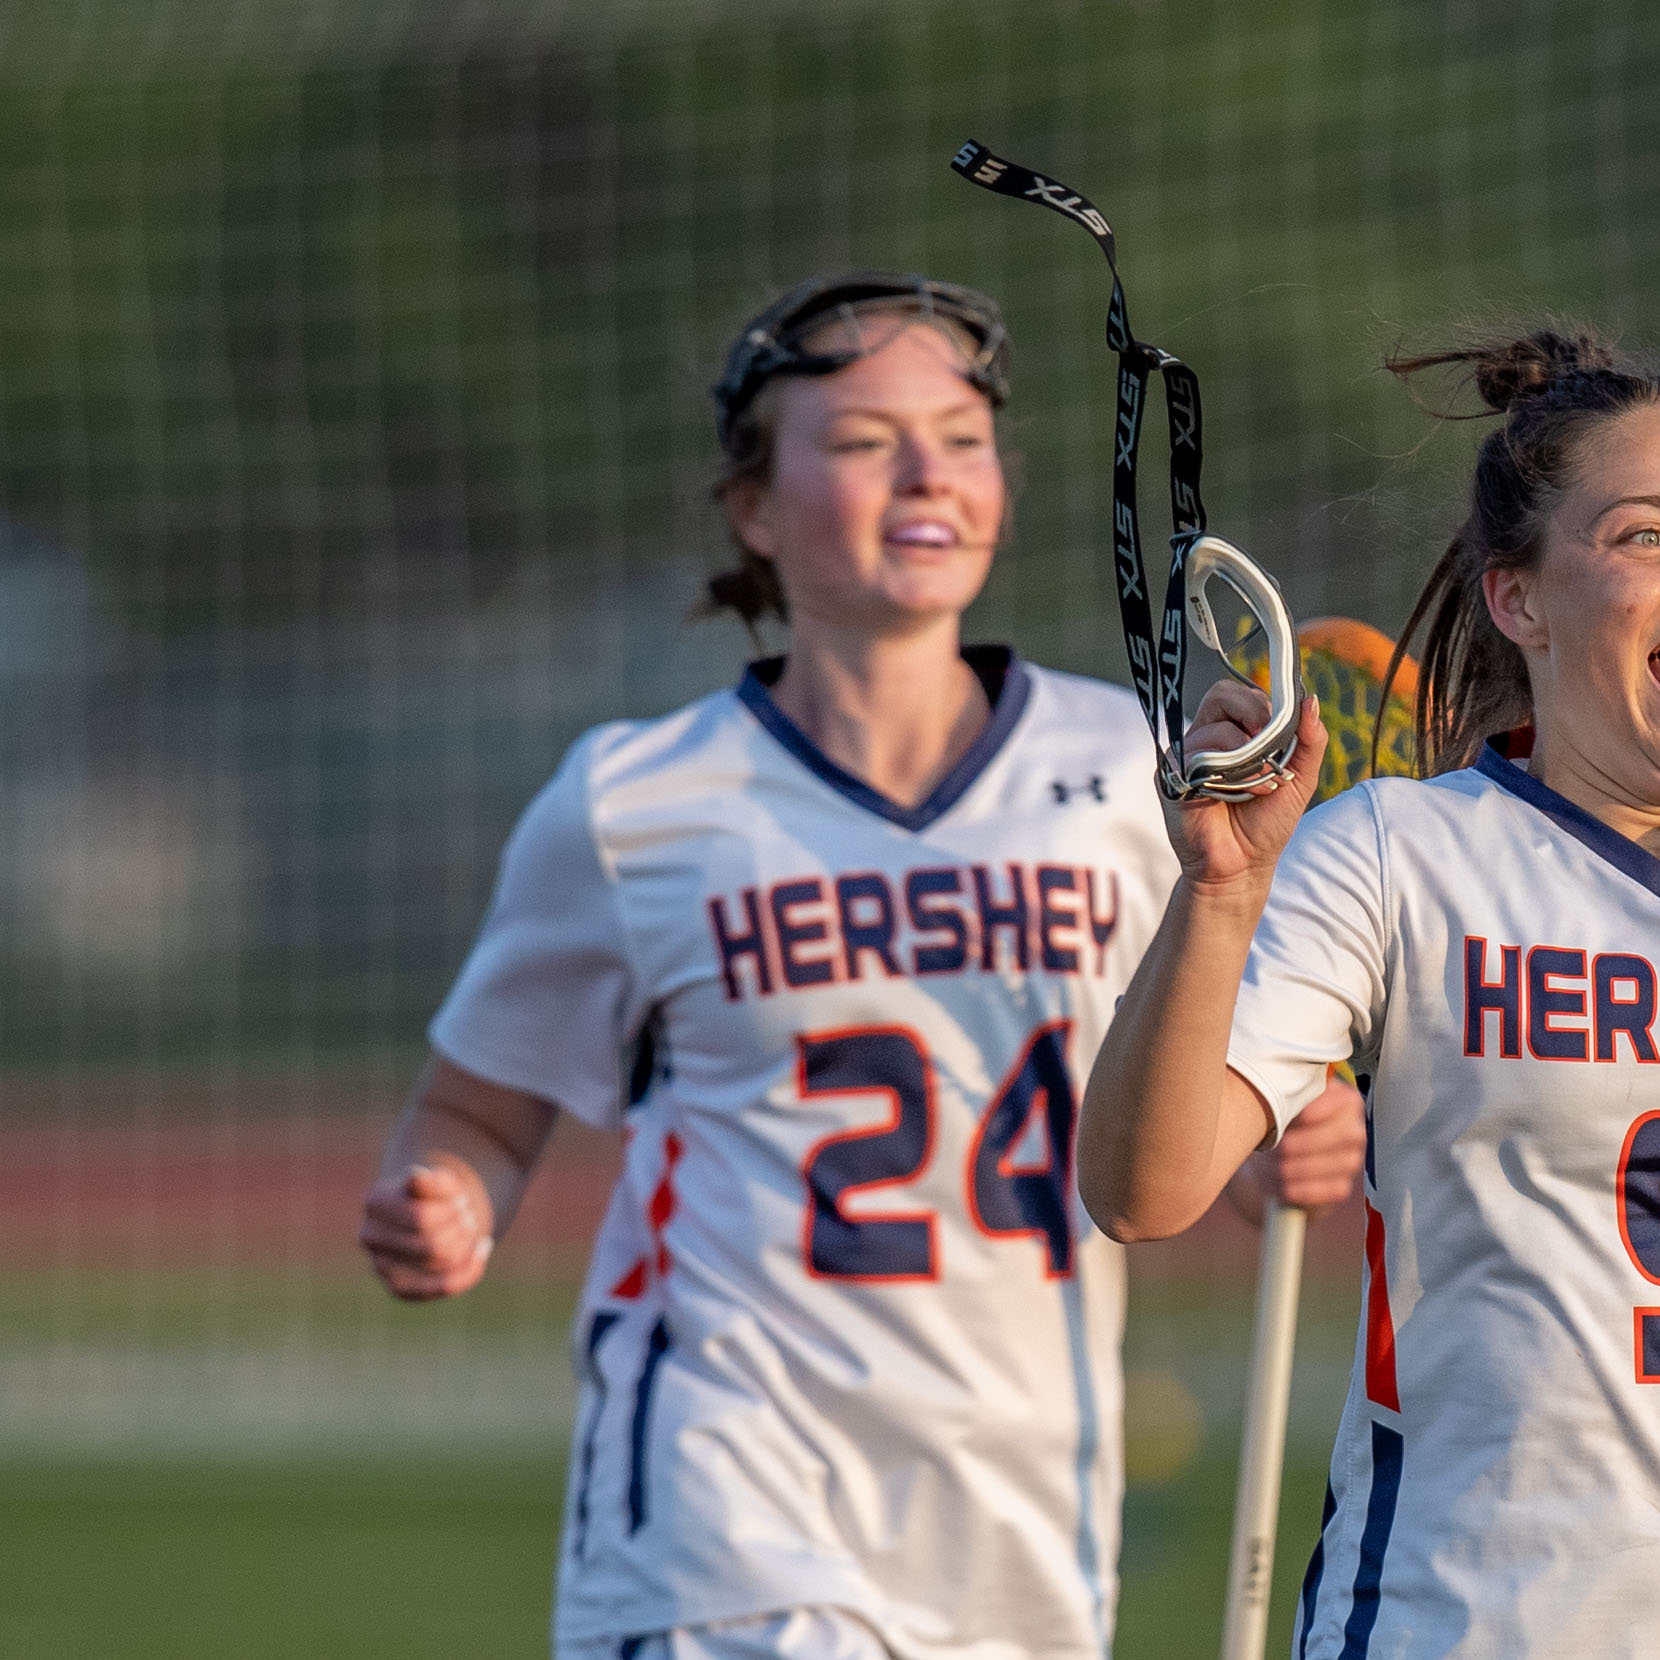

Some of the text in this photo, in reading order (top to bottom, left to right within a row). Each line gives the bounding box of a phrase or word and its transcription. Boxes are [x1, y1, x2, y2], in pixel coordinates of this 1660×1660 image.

[1024, 176, 1113, 236] STX
[1116, 367, 1141, 472] STX
[1169, 373, 1196, 451] STX
[1116, 497, 1143, 601] STX
[1162, 608, 1182, 709] STX
[708, 861, 1121, 1002] HERSHEY
[796, 1018, 1078, 1283] 24
